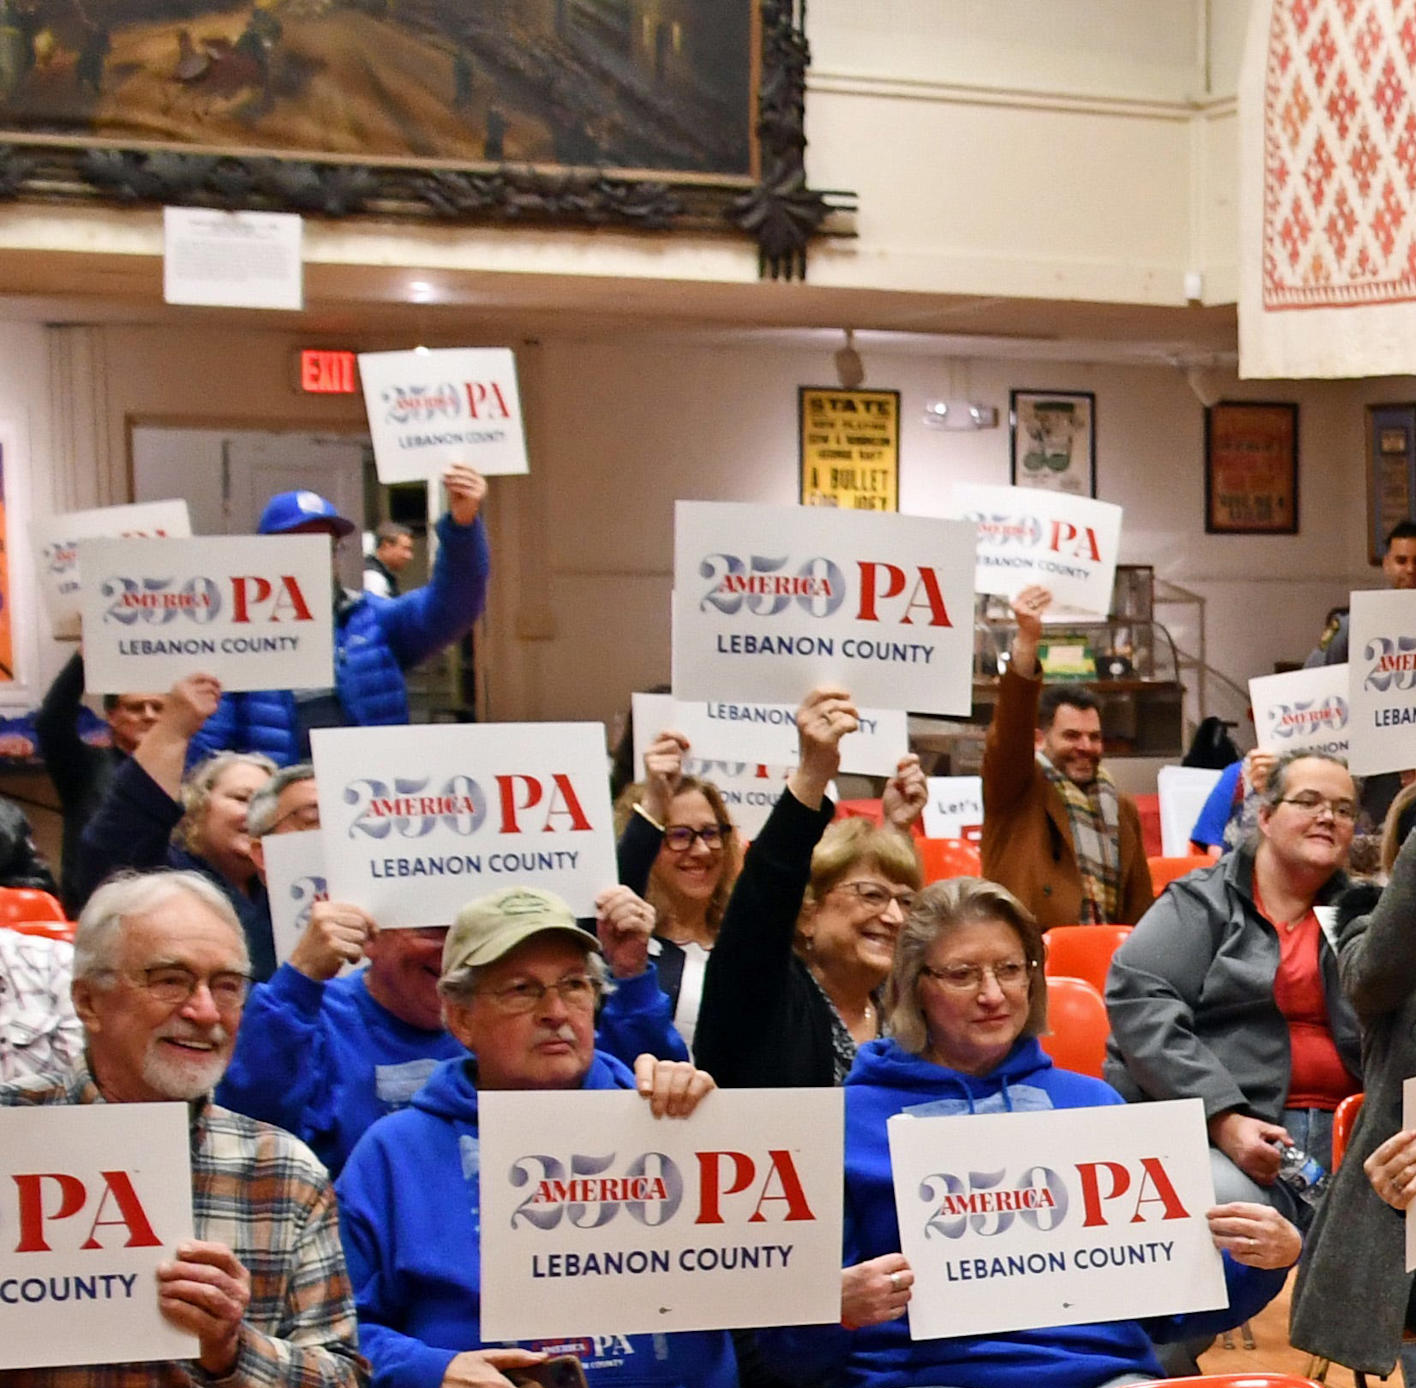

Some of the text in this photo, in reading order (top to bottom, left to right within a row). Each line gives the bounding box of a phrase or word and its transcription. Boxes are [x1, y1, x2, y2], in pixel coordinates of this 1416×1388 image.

[302, 351, 355, 391] EXIT
[464, 381, 511, 420] PA
[399, 434, 463, 449] LEBANON
[1049, 520, 1102, 563] PA
[101, 575, 314, 626] 250 PA
[117, 591, 212, 609] AMERICA
[700, 554, 954, 628] 250 PA
[719, 574, 833, 597] AMERICA
[119, 637, 298, 655] LEBANON COUNTY
[718, 635, 934, 663] LEBANON COUNTY
[344, 773, 594, 839] 250 PA
[366, 796, 476, 818] AMERICA
[371, 852, 577, 878] LEBANON COUNTY
[510, 1149, 818, 1230] 250 PA
[532, 1177, 668, 1204] AMERICA
[919, 1157, 1191, 1240] 250 PA
[940, 1188, 1055, 1215] AMERICA
[12, 1170, 164, 1253] PA
[533, 1245, 792, 1277] LEBANON COUNTY
[947, 1242, 1173, 1281] LEBANON COUNTY
[0, 1274, 137, 1303] COUNTY
